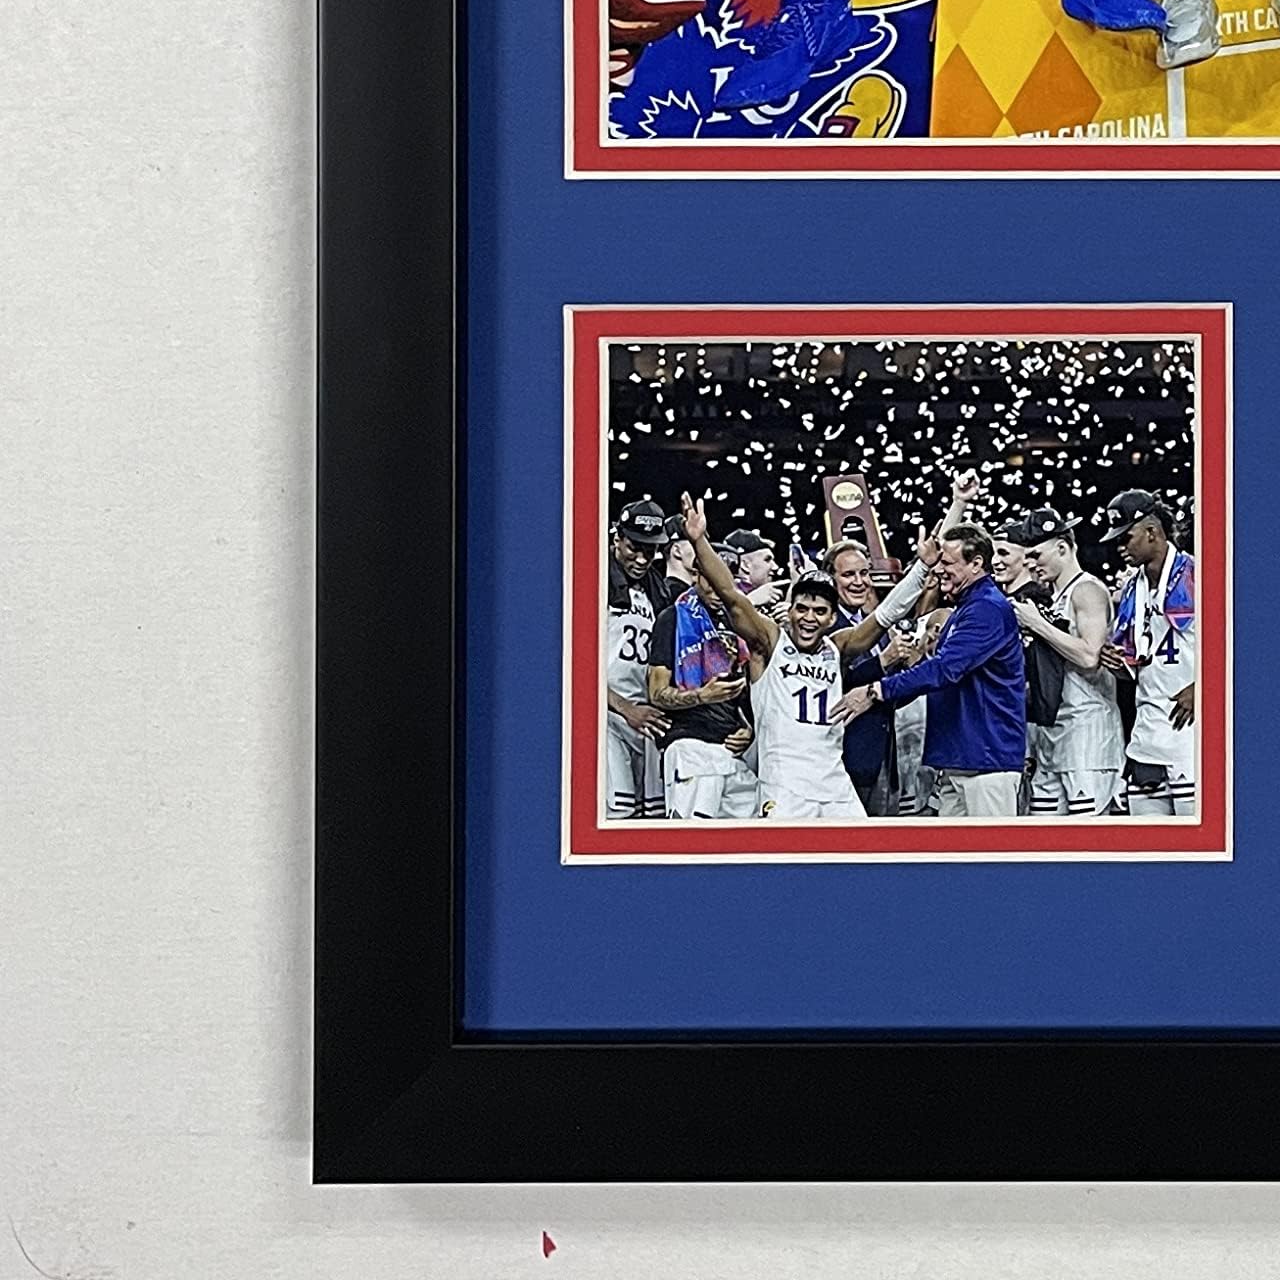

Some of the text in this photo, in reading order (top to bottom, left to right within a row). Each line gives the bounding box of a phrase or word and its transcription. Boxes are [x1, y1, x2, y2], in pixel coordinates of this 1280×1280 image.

[619, 624, 652, 665] 33
[779, 663, 838, 686] KANSAS
[792, 686, 833, 726] 11
